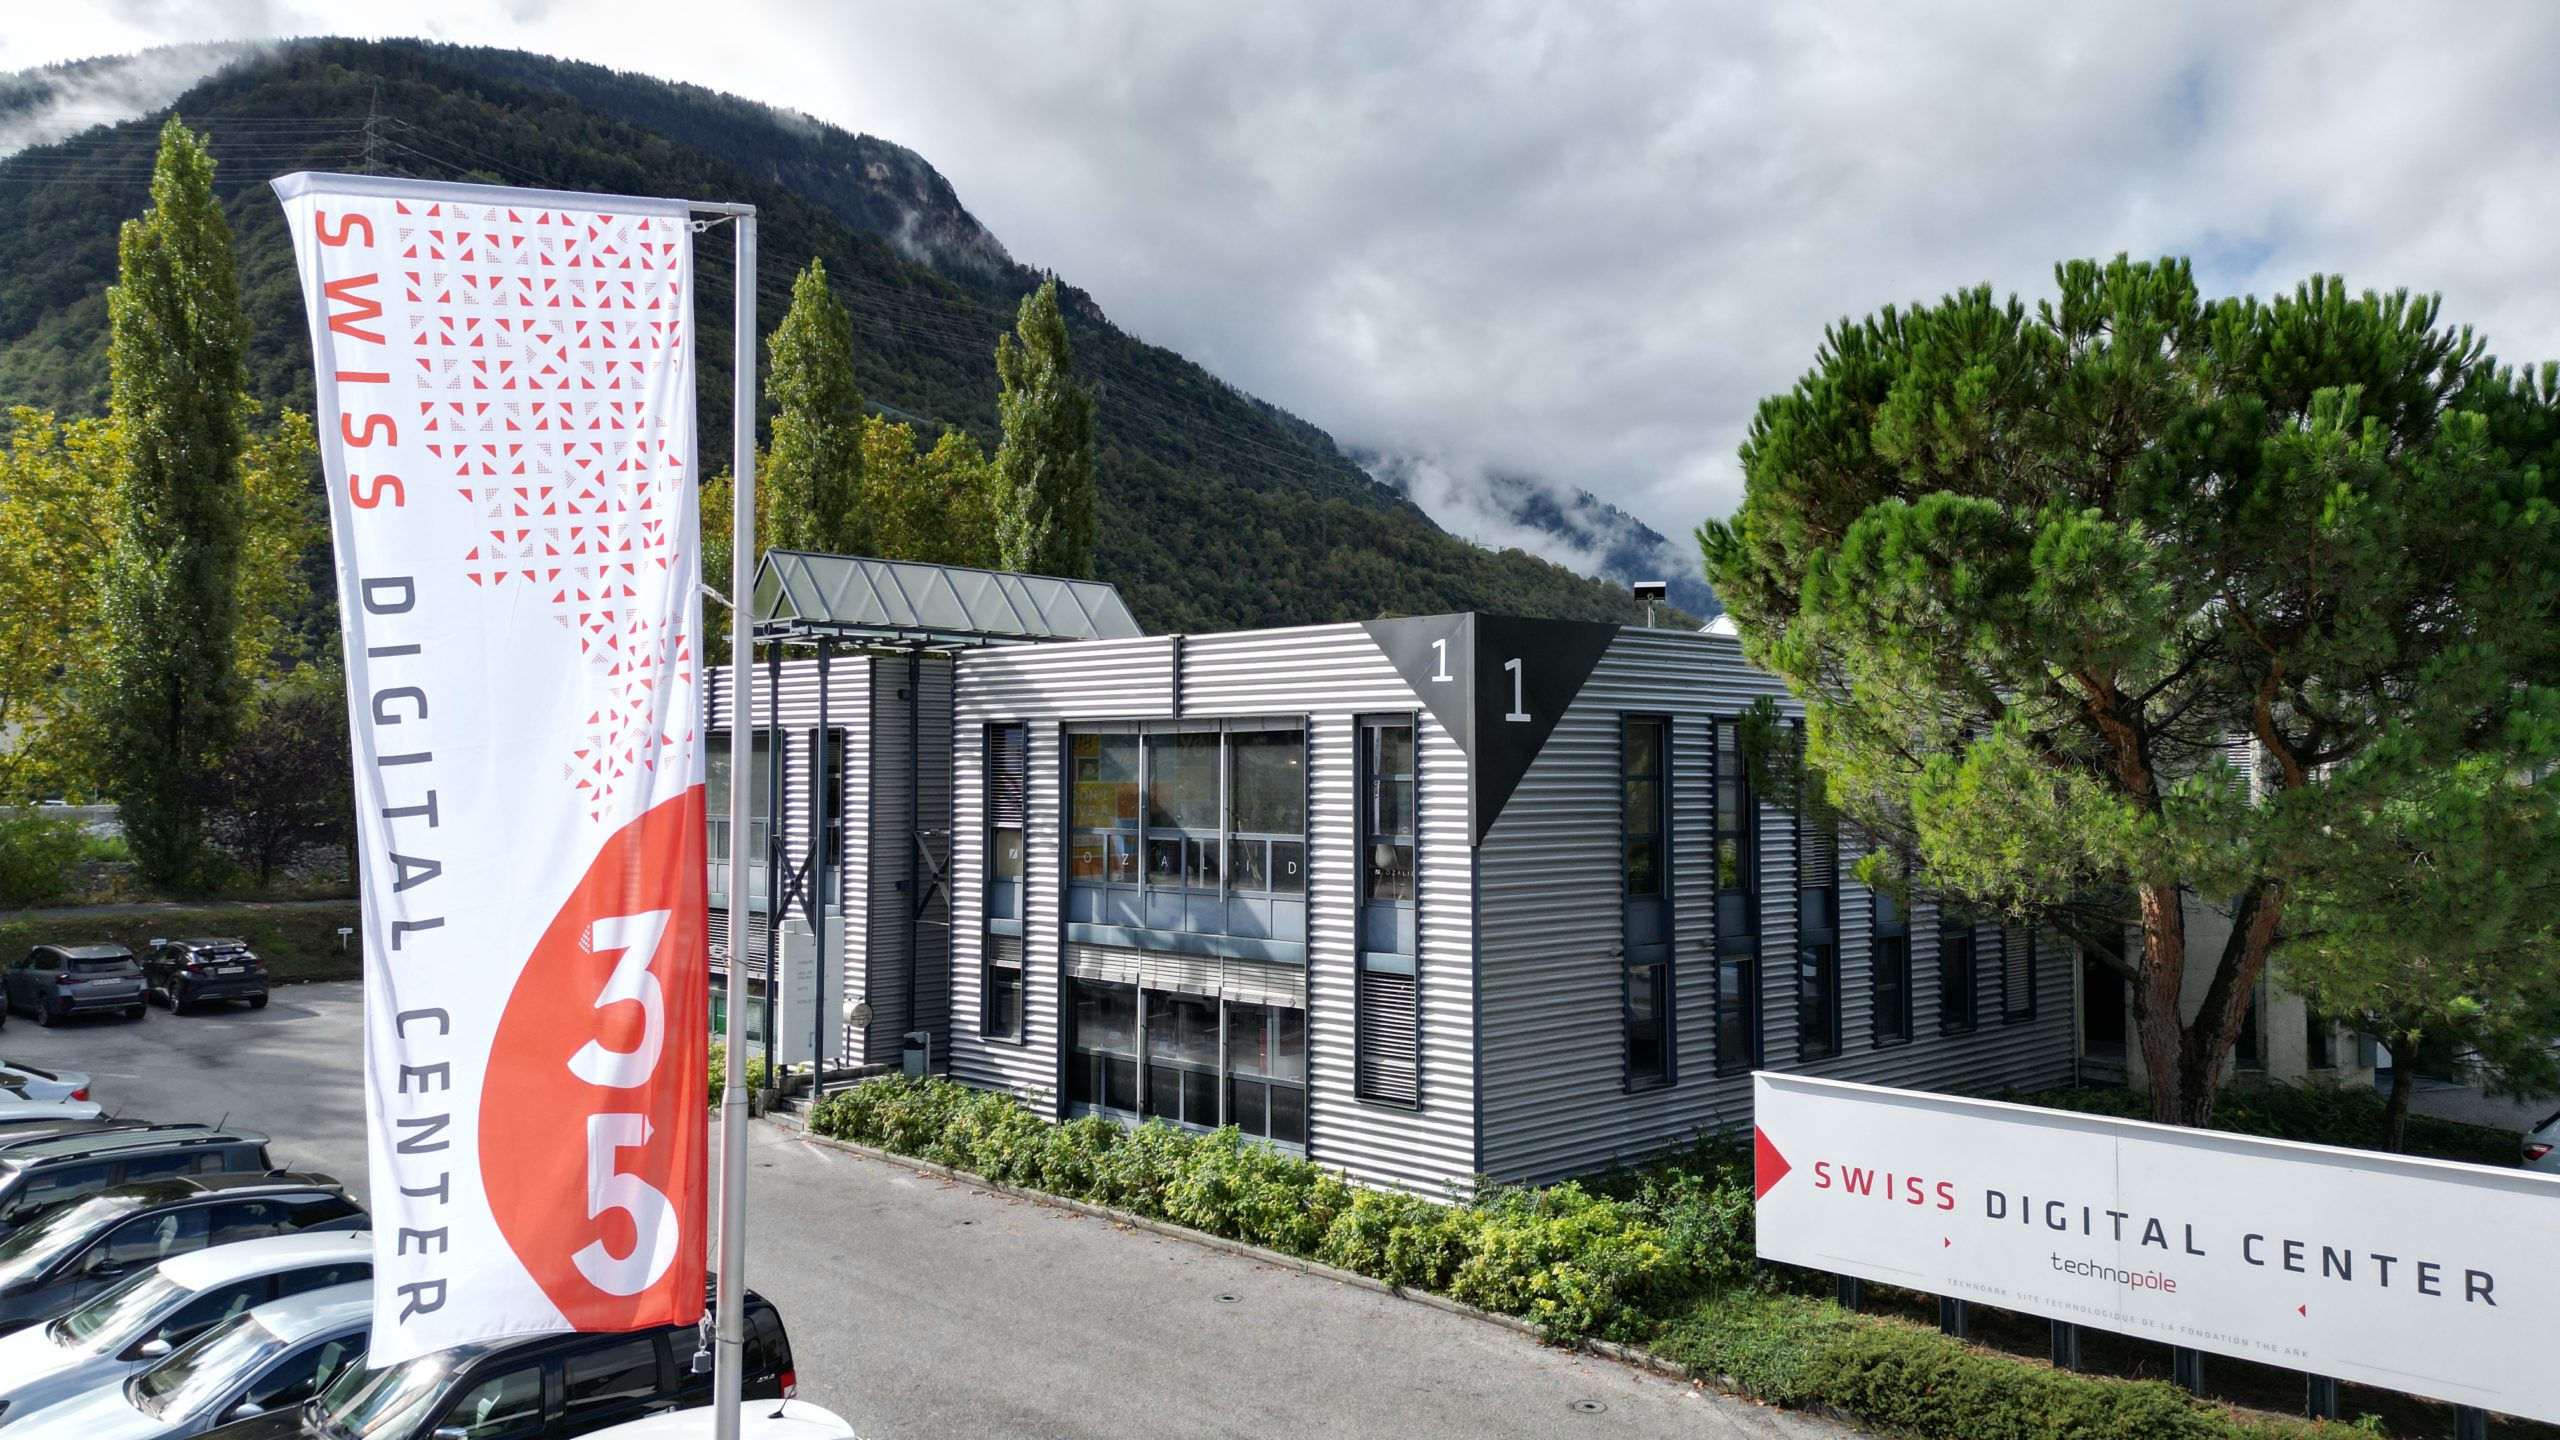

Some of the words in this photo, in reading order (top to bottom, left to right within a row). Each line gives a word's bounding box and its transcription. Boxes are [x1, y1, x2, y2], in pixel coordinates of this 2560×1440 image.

[315, 209, 405, 510] SWISS
[1431, 638, 1454, 682] 1
[1504, 657, 1532, 723] 1
[361, 575, 445, 952] DIGITAL
[395, 1006, 451, 1325] CENTER
[1813, 1160, 1955, 1211] SWISS
[1986, 1189, 2206, 1256] DIGITAL
[2242, 1233, 2498, 1307] CENTER
[2050, 1252, 2177, 1294] technopôle
[1947, 1278, 2007, 1297] TECHNOARK
[2017, 1292, 2040, 1303] SITE
[2045, 1298, 2135, 1324] TECHNOLOGIQUE
[2142, 1318, 2156, 1328] DE
[2161, 1322, 2175, 1332] LA
[2181, 1326, 2249, 1347] FONDATION
[2256, 1341, 2278, 1352] THE
[2284, 1347, 2309, 1359] ARK
